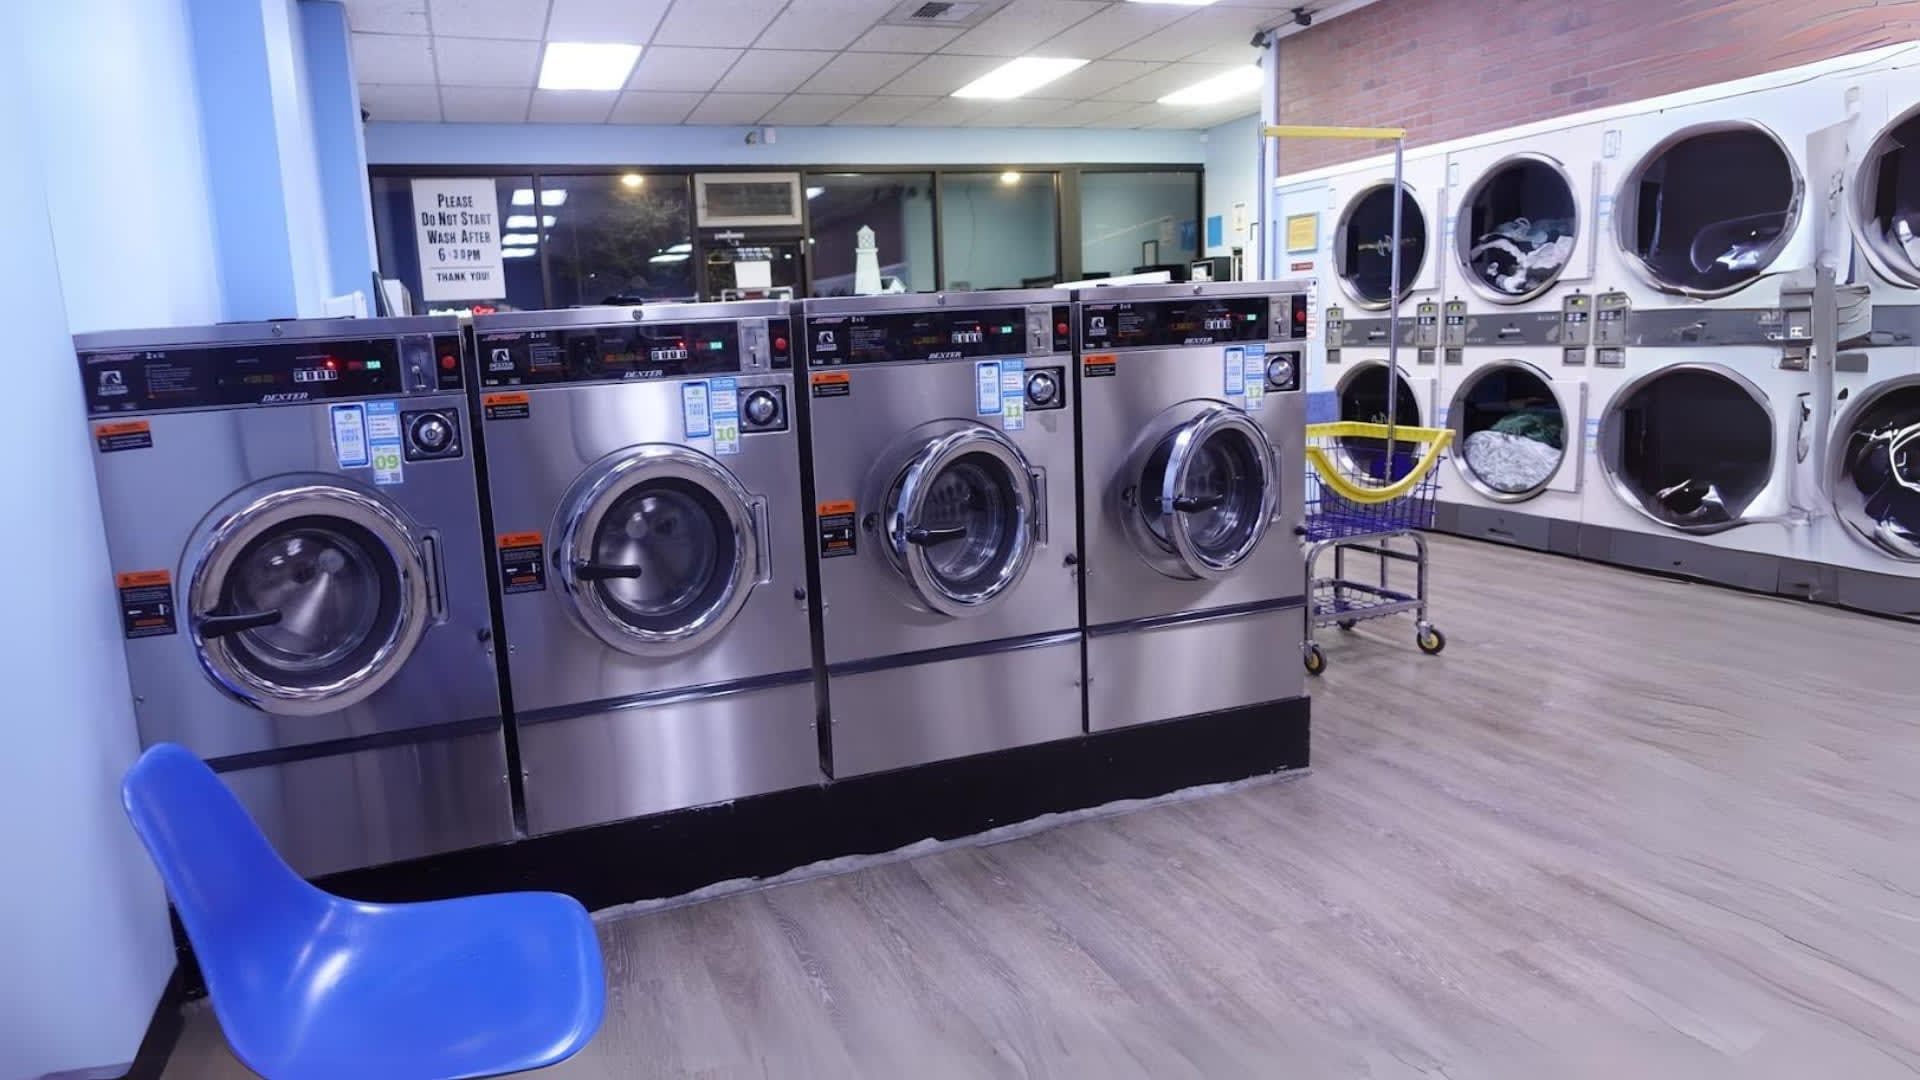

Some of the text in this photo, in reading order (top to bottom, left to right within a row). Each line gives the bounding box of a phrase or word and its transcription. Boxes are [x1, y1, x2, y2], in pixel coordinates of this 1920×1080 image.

[437, 193, 473, 208] PLEASE
[421, 211, 491, 226] DO NOT START
[427, 229, 491, 244] WASH AFTER
[436, 271, 490, 283] THANK YOU!
[624, 369, 663, 379] DEXTER
[261, 391, 309, 403] DEXTER
[717, 426, 736, 442] 10
[374, 454, 399, 471] 09
